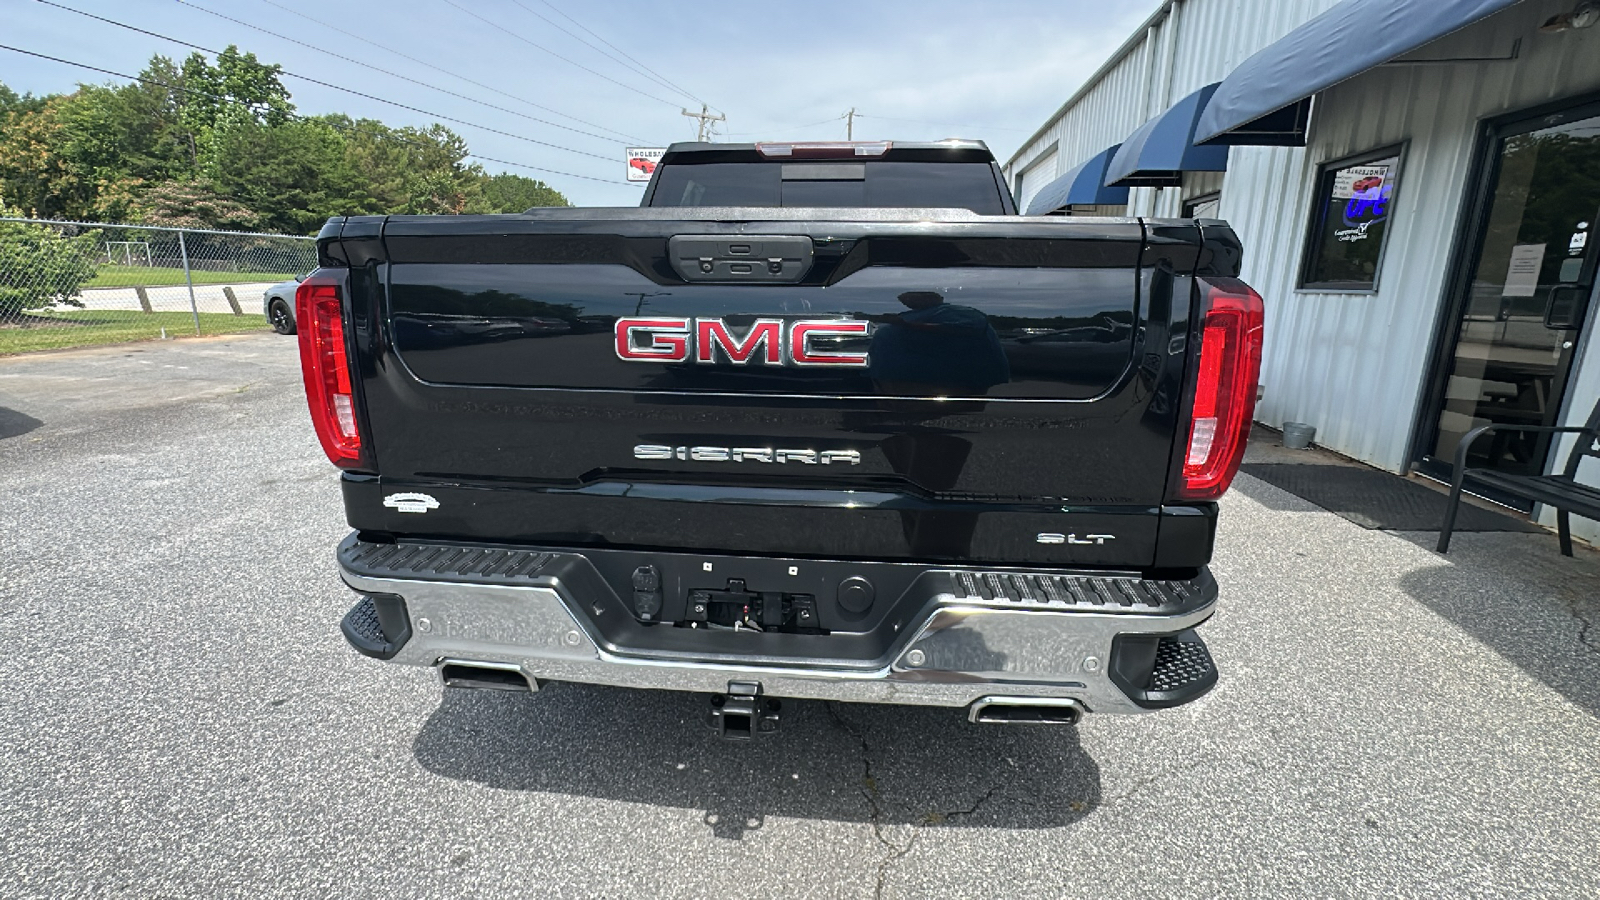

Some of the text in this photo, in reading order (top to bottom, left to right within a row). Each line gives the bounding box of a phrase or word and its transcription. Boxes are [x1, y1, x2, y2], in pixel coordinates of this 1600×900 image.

[614, 317, 870, 368] GMC
[633, 444, 861, 465] SIERRA
[1036, 532, 1116, 545] SLT
